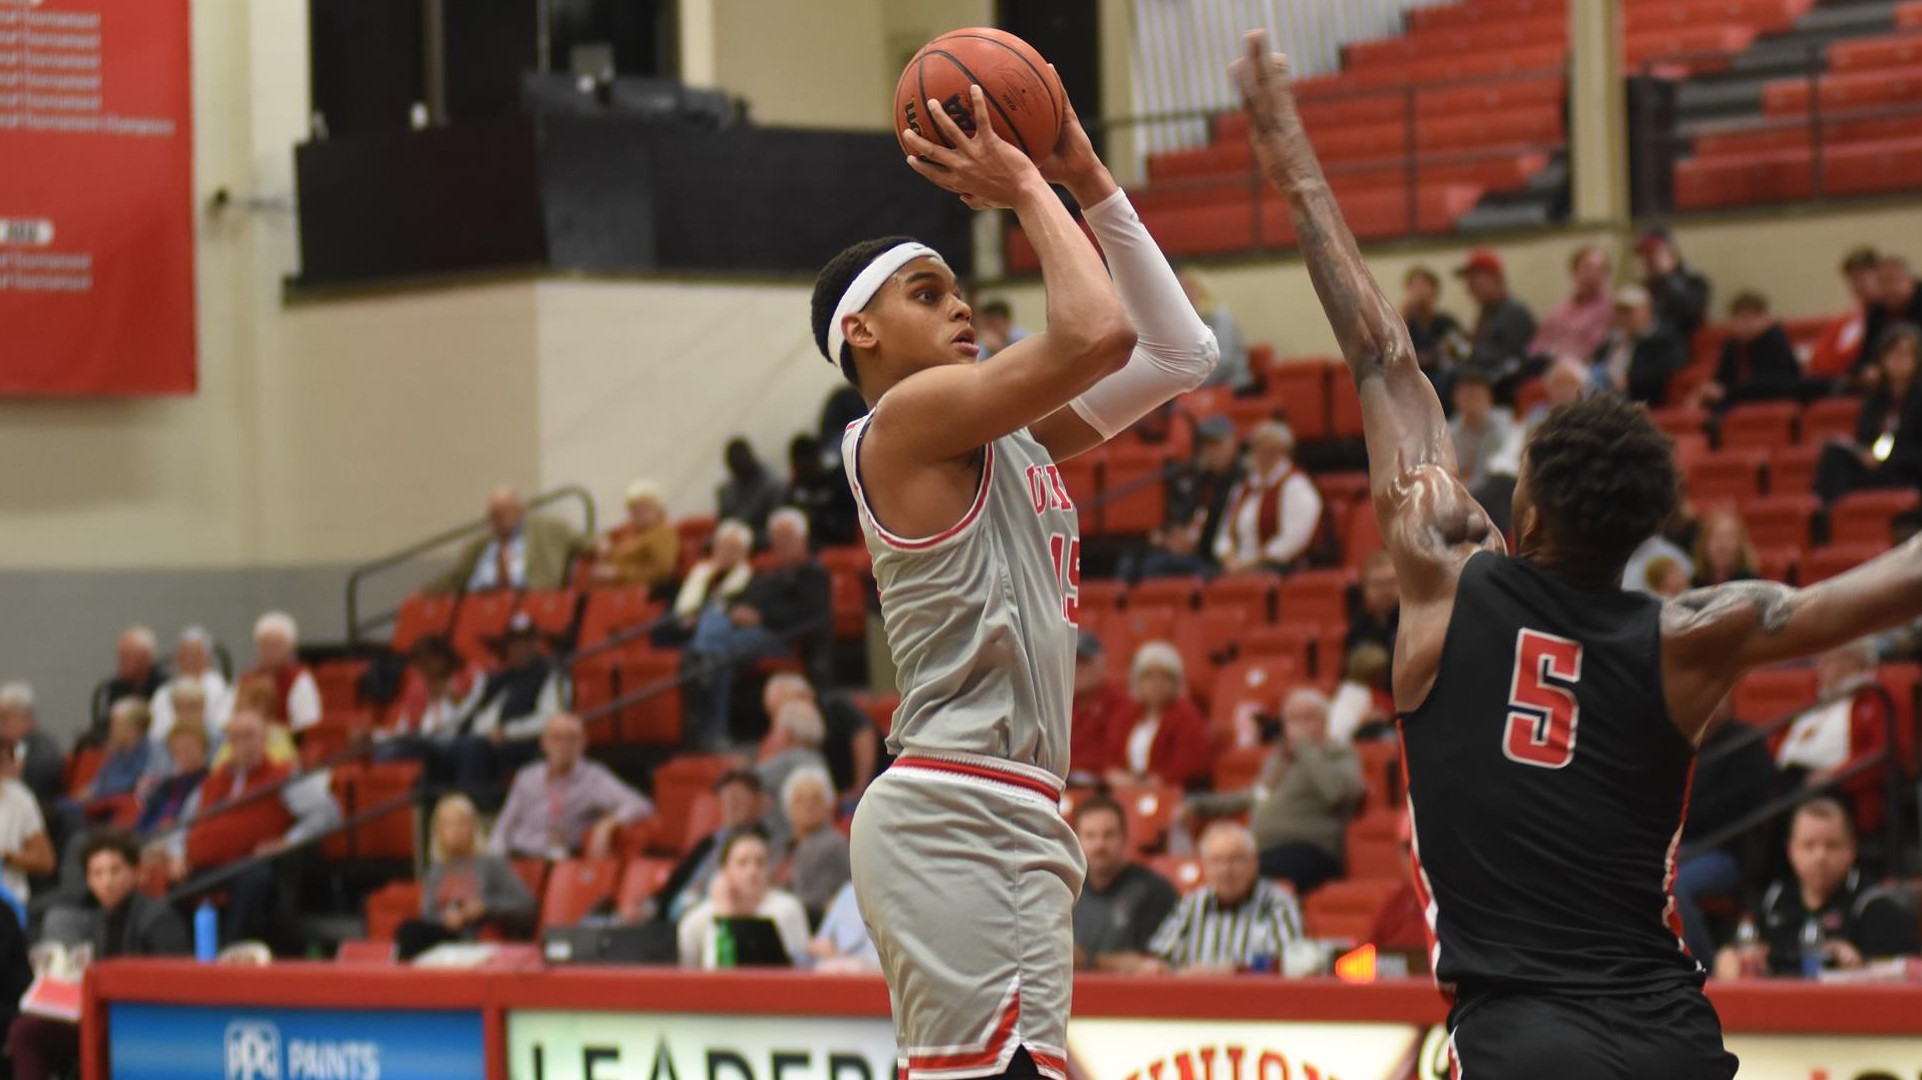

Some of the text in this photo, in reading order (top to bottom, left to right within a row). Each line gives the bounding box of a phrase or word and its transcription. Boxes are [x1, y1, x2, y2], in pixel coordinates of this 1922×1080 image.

[1502, 627, 1584, 769] 5
[288, 1039, 381, 1080] PAINTS
[533, 1038, 898, 1080] LEADER
